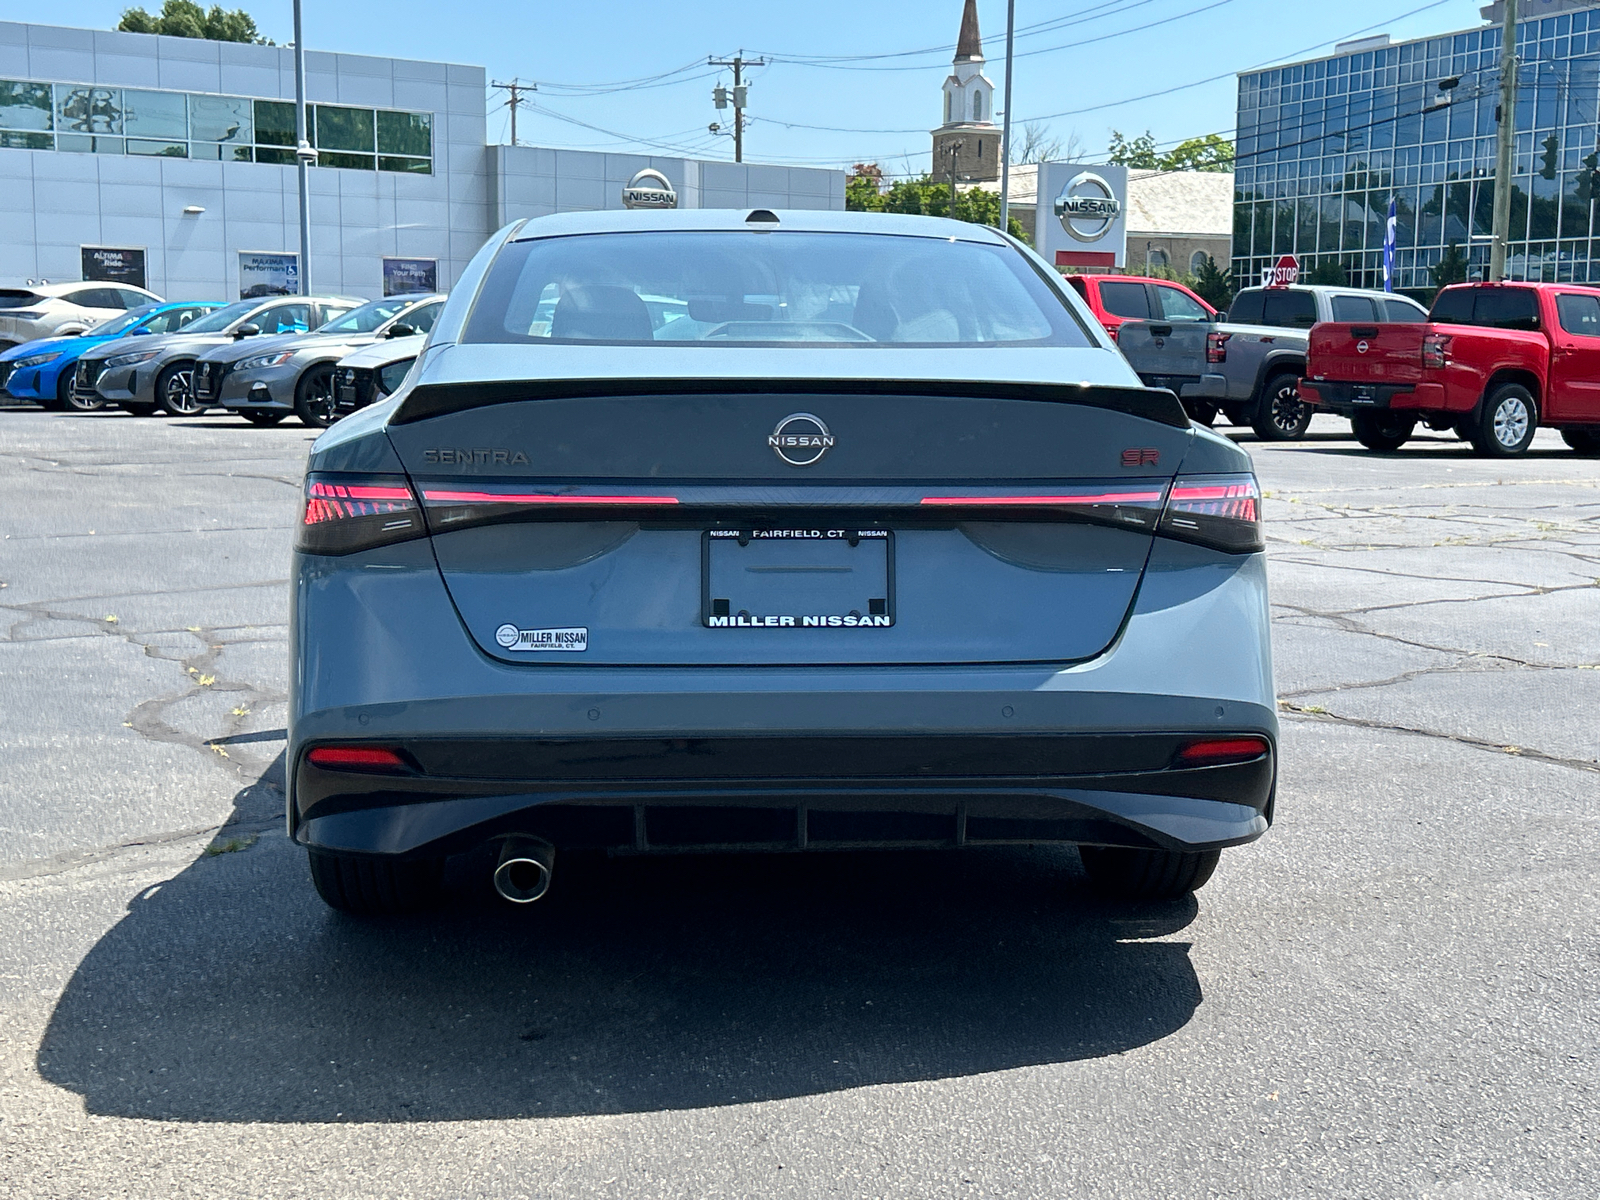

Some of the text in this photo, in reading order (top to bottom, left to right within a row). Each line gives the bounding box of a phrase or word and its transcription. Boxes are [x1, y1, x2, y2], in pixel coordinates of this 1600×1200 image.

[629, 192, 674, 203] NISSAN
[1063, 201, 1117, 213] NISSAN
[93, 251, 123, 260] ALTIMA
[409, 270, 426, 278] Path
[1276, 267, 1297, 282] STOP
[768, 436, 834, 446] NISSAN
[424, 448, 531, 465] SENTRA
[1121, 447, 1160, 467] SR
[752, 530, 845, 539] FAIRFIELD, CT
[709, 616, 890, 627] MILLER NISSAN
[520, 632, 586, 643] MILLER NISSAN
